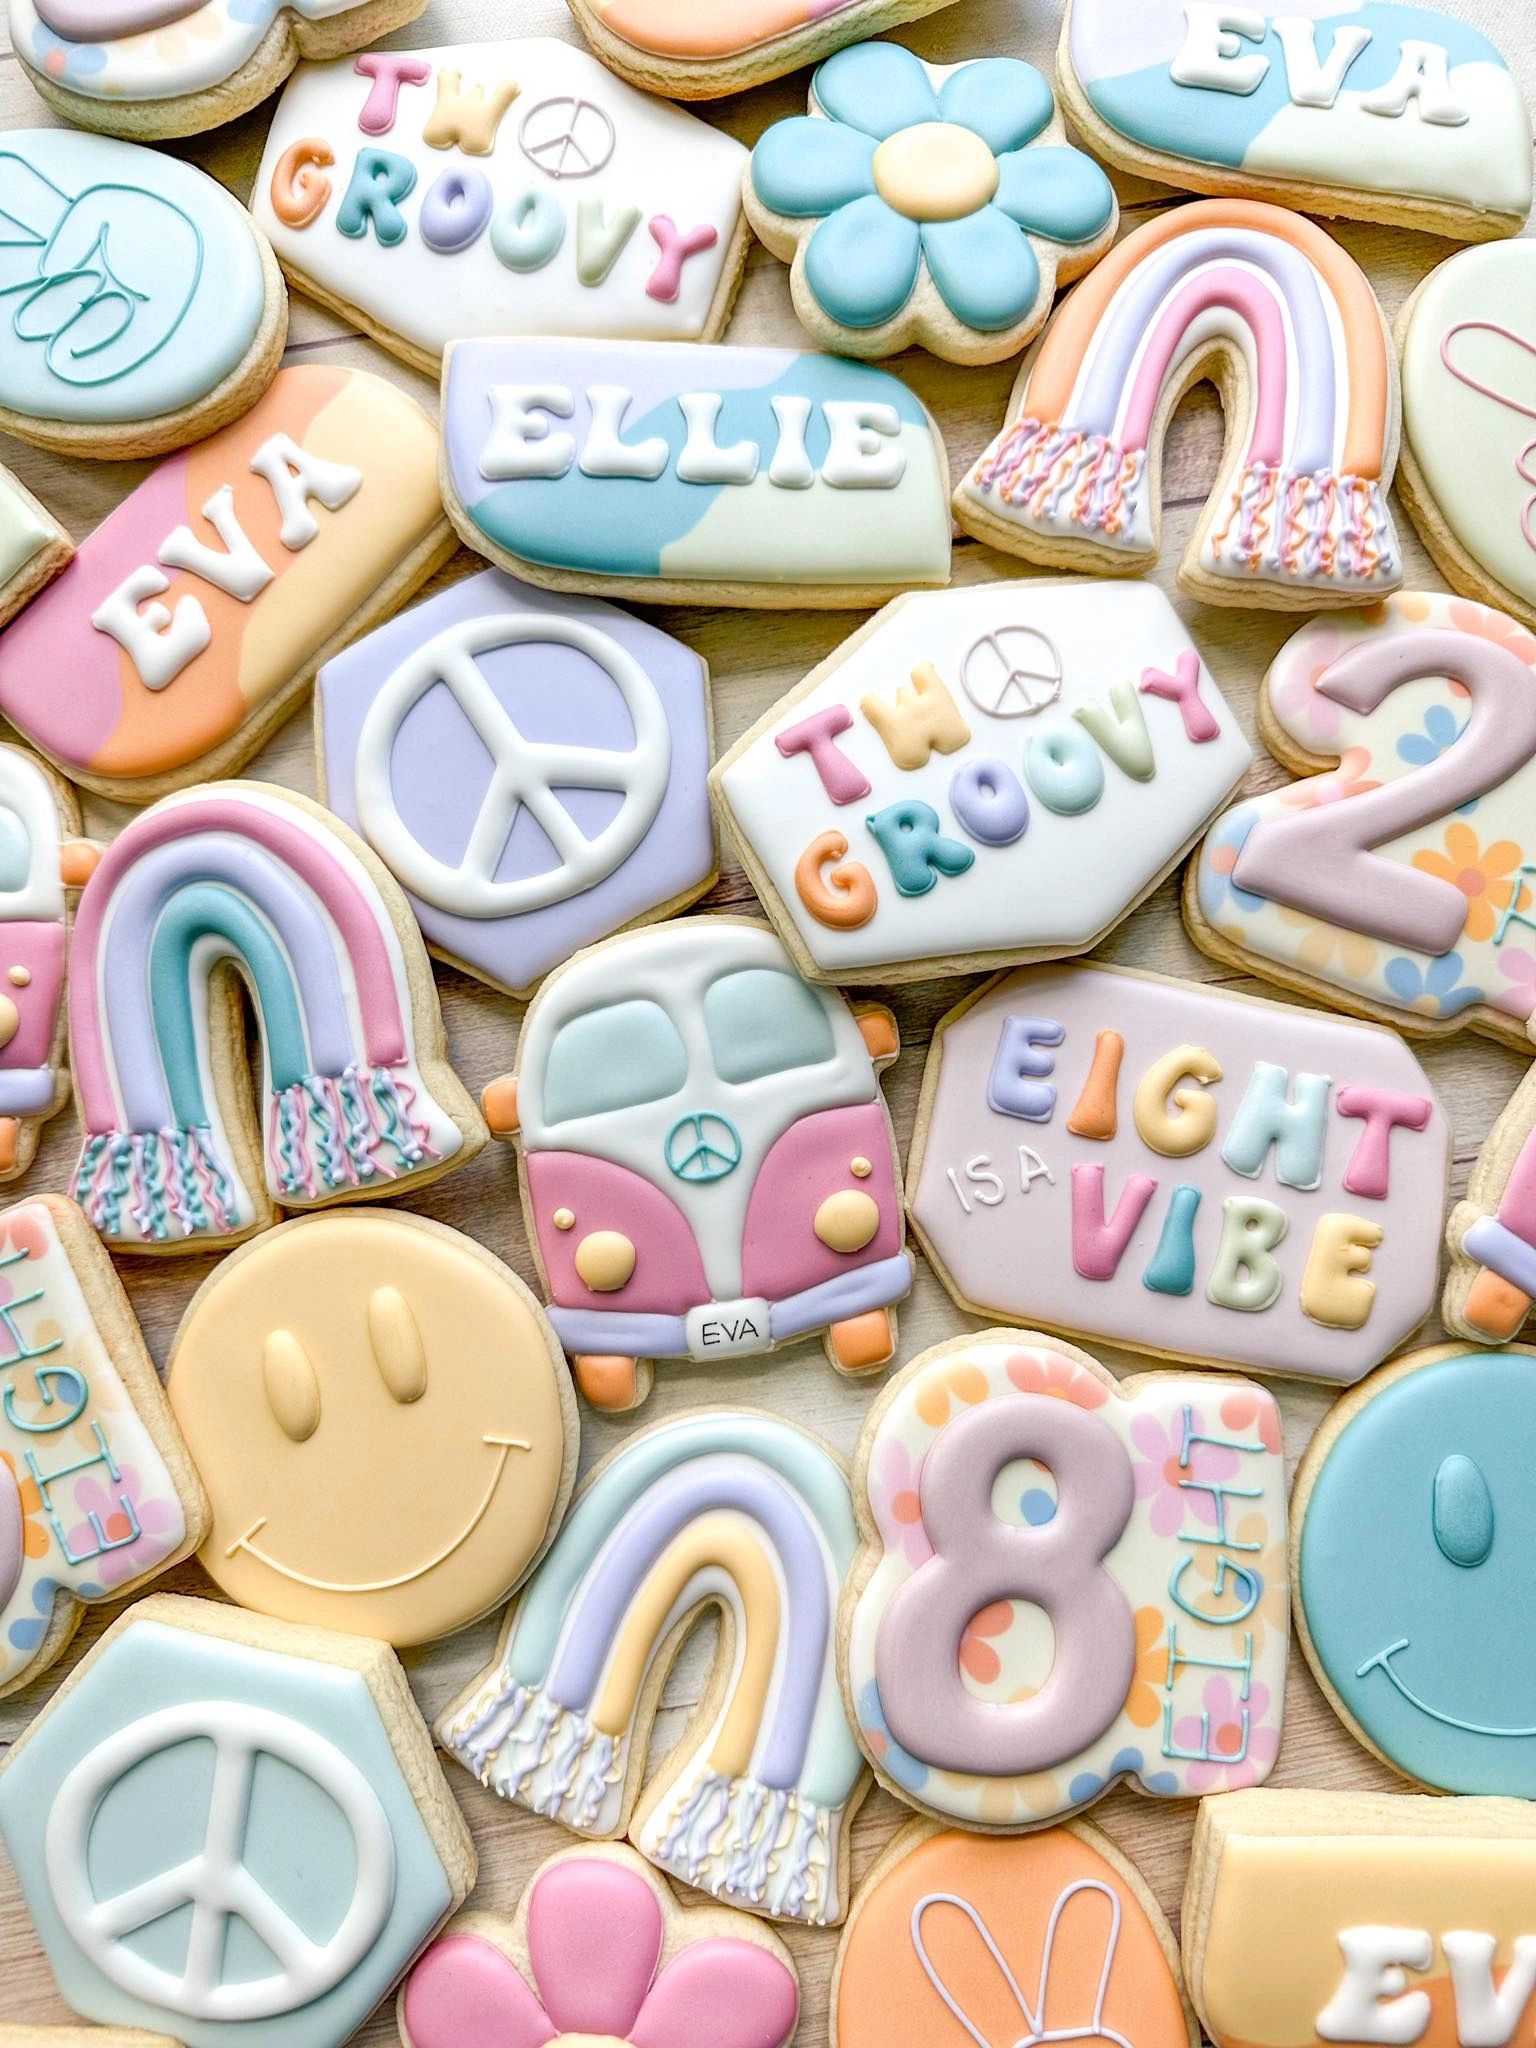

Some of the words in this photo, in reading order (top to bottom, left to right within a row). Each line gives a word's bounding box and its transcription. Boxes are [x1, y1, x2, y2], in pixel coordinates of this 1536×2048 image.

[1169, 3, 1470, 127] EVA
[270, 138, 719, 302] GROOVY
[479, 384, 907, 490] ELLIE
[91, 432, 364, 691] EVA
[795, 649, 1222, 930] GROOVY
[1239, 628, 1536, 957] 2
[986, 1015, 1433, 1199] EIGHT
[946, 1153, 1006, 1214] IS
[1018, 1144, 1056, 1194] A
[1070, 1162, 1384, 1331] VIBE
[702, 1318, 759, 1346] EVA
[875, 1393, 1136, 1776] 8
[1161, 1403, 1267, 1764] EIGHT
